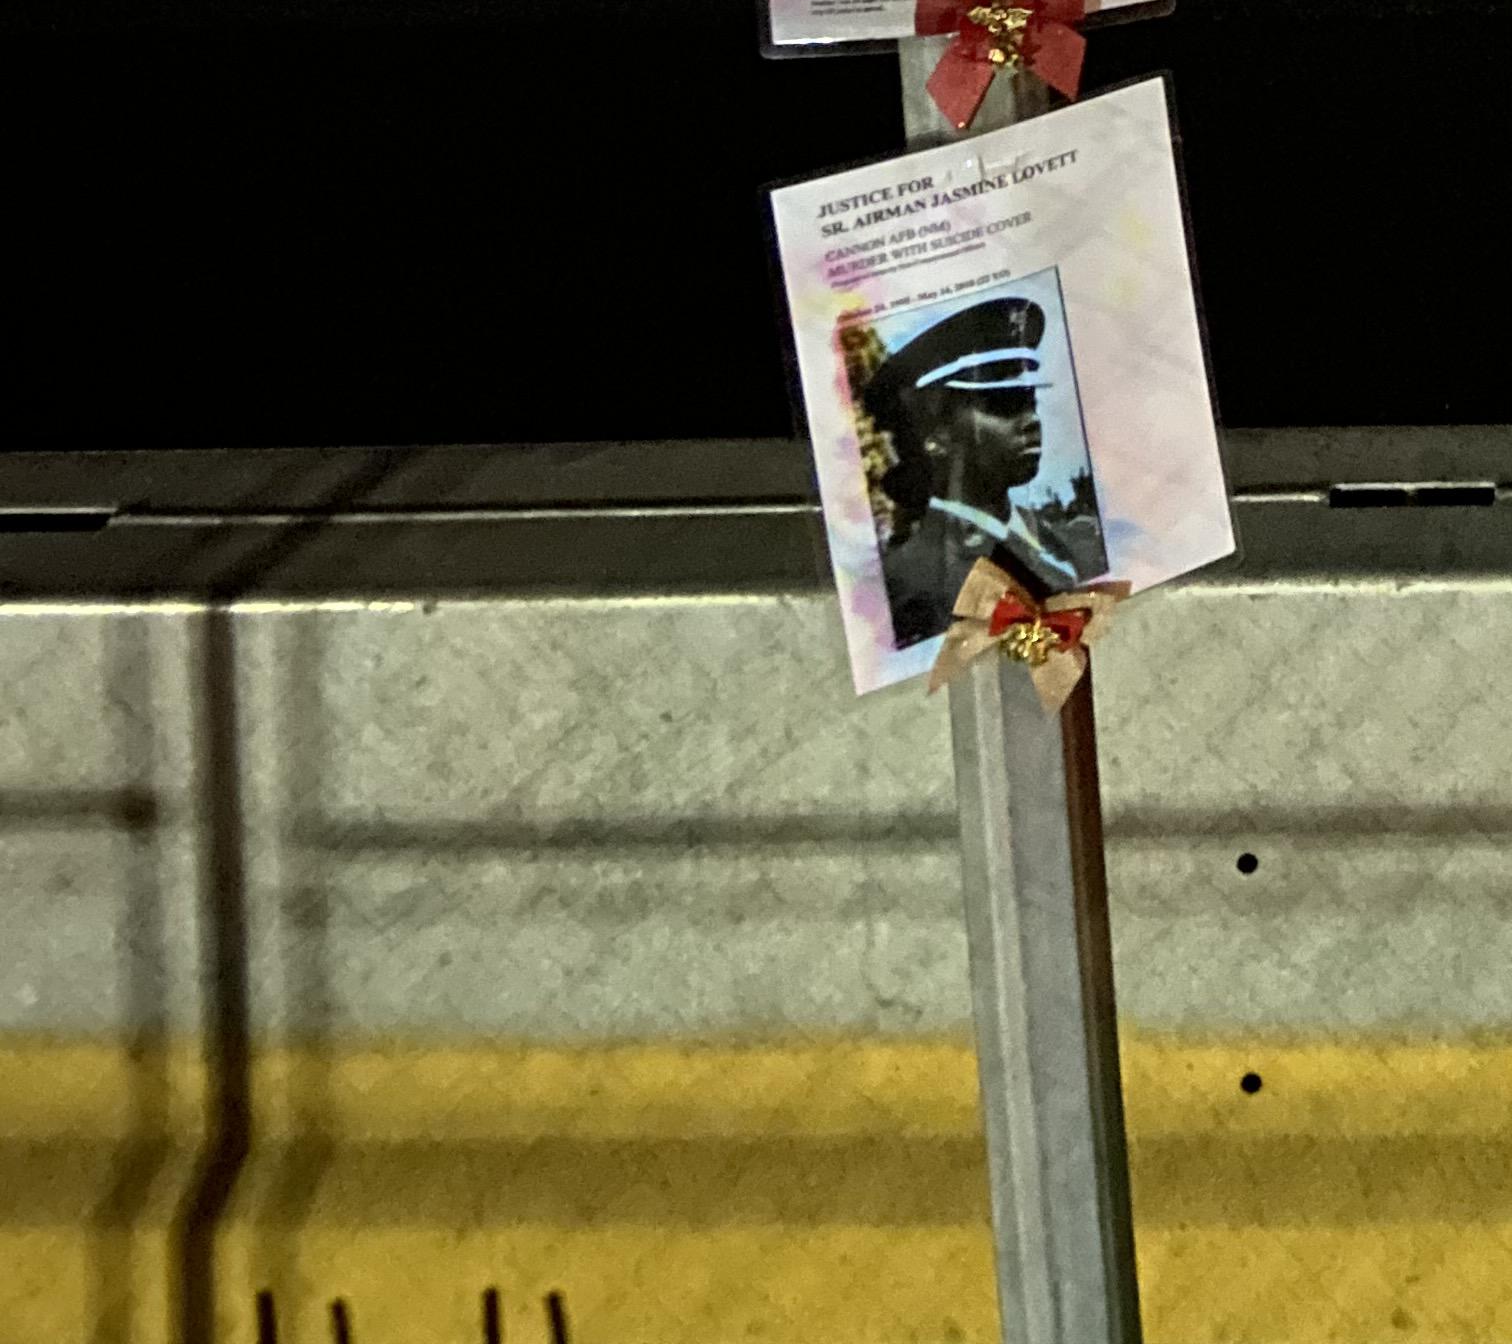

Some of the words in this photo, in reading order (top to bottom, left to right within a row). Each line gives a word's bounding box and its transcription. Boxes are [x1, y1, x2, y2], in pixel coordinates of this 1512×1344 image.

[817, 187, 895, 219] JUSTICE
[898, 176, 935, 197] FOR
[821, 221, 850, 238] SR.
[853, 198, 927, 230] AIRMAN
[930, 173, 1009, 208] JASMINE
[1012, 149, 1079, 185] LOVETT
[824, 236, 886, 262] CANNON
[889, 227, 917, 245] AFB
[827, 251, 888, 278] MURDER
[891, 242, 928, 260] WITH
[930, 227, 984, 252] SUICIDE
[986, 211, 1032, 236] COVER
